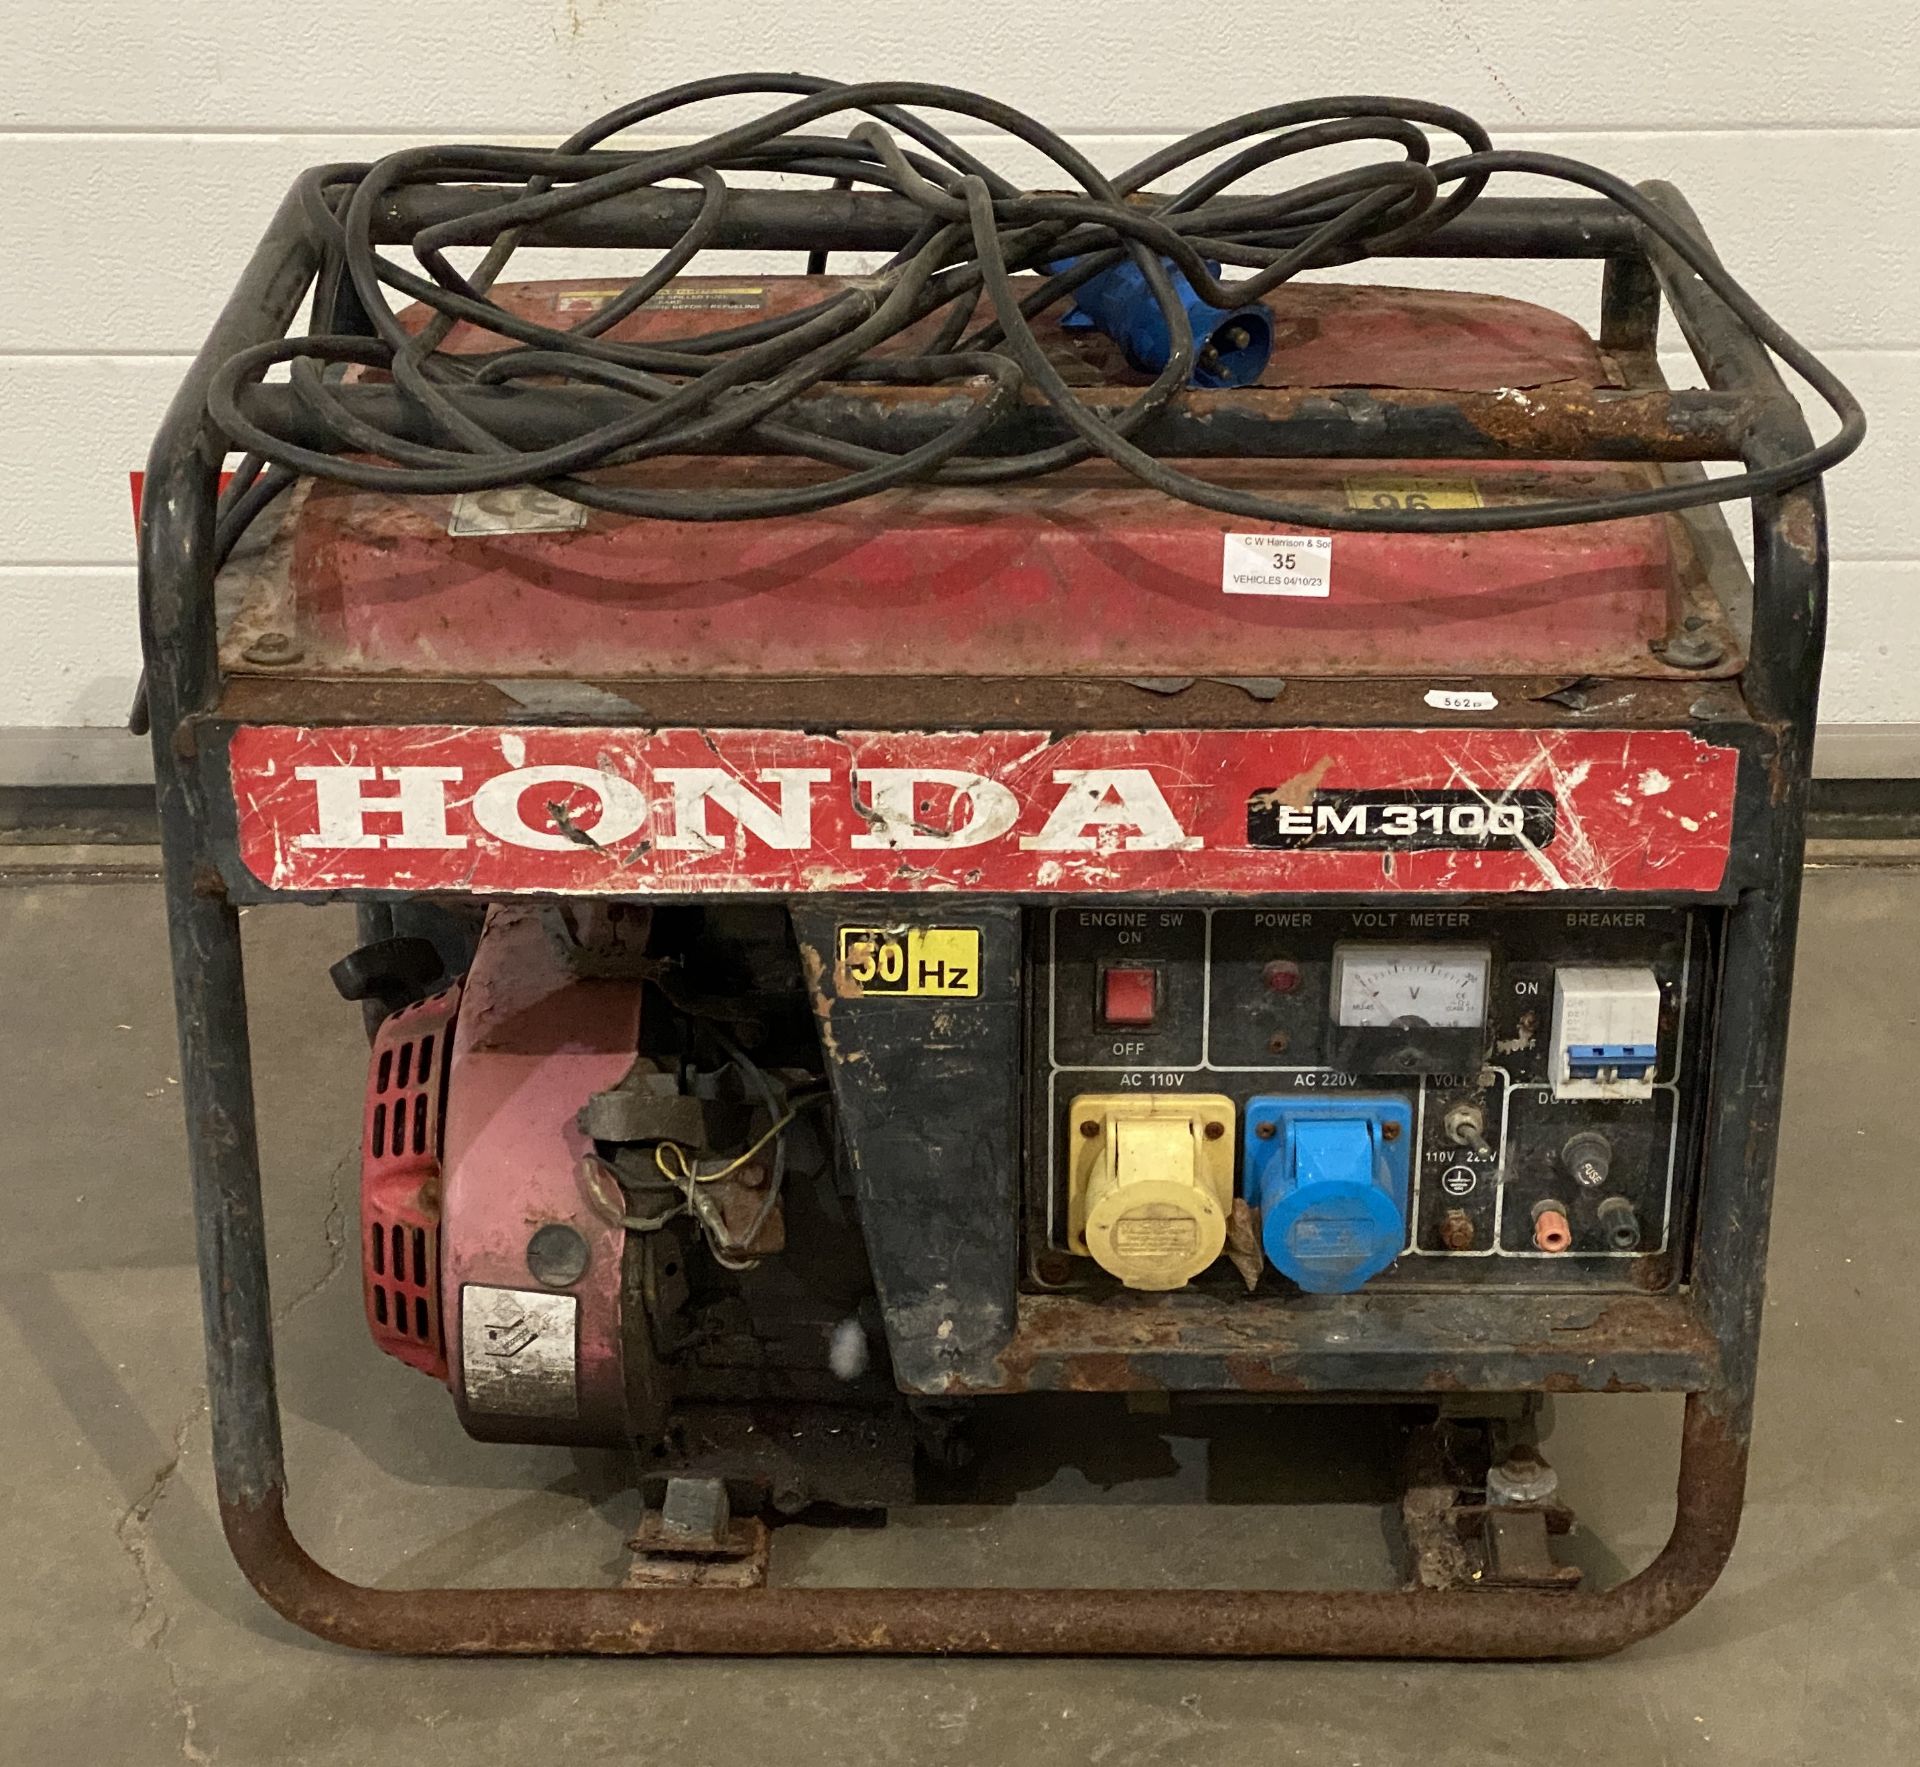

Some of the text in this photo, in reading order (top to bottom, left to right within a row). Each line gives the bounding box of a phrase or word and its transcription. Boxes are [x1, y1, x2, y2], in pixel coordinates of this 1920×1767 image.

[1245, 537, 1252, 545] C
[1255, 537, 1265, 546] W
[1267, 537, 1305, 548] Harrison
[1307, 539, 1313, 548] &
[1273, 553, 1296, 570] 35
[1233, 574, 1322, 587] VEHICLES 04/10/23
[295, 764, 1204, 851] HONDA
[1278, 805, 1525, 837] EM 3100
[1079, 912, 1184, 927] ENGINE SW
[1254, 912, 1312, 927] POWER
[1352, 912, 1470, 927] VOLT METER
[1566, 912, 1646, 927] BREAKER
[1117, 930, 1142, 945] ON
[850, 941, 969, 989] 50 Hz
[1409, 986, 1421, 1000] V
[1514, 981, 1539, 996] ON
[1112, 1042, 1146, 1056] OFF
[1120, 1073, 1185, 1087] AC 110V
[1294, 1073, 1358, 1087] AC 220V
[1425, 1152, 1455, 1163] 110V
[1584, 1162, 1602, 1184] FUSE
